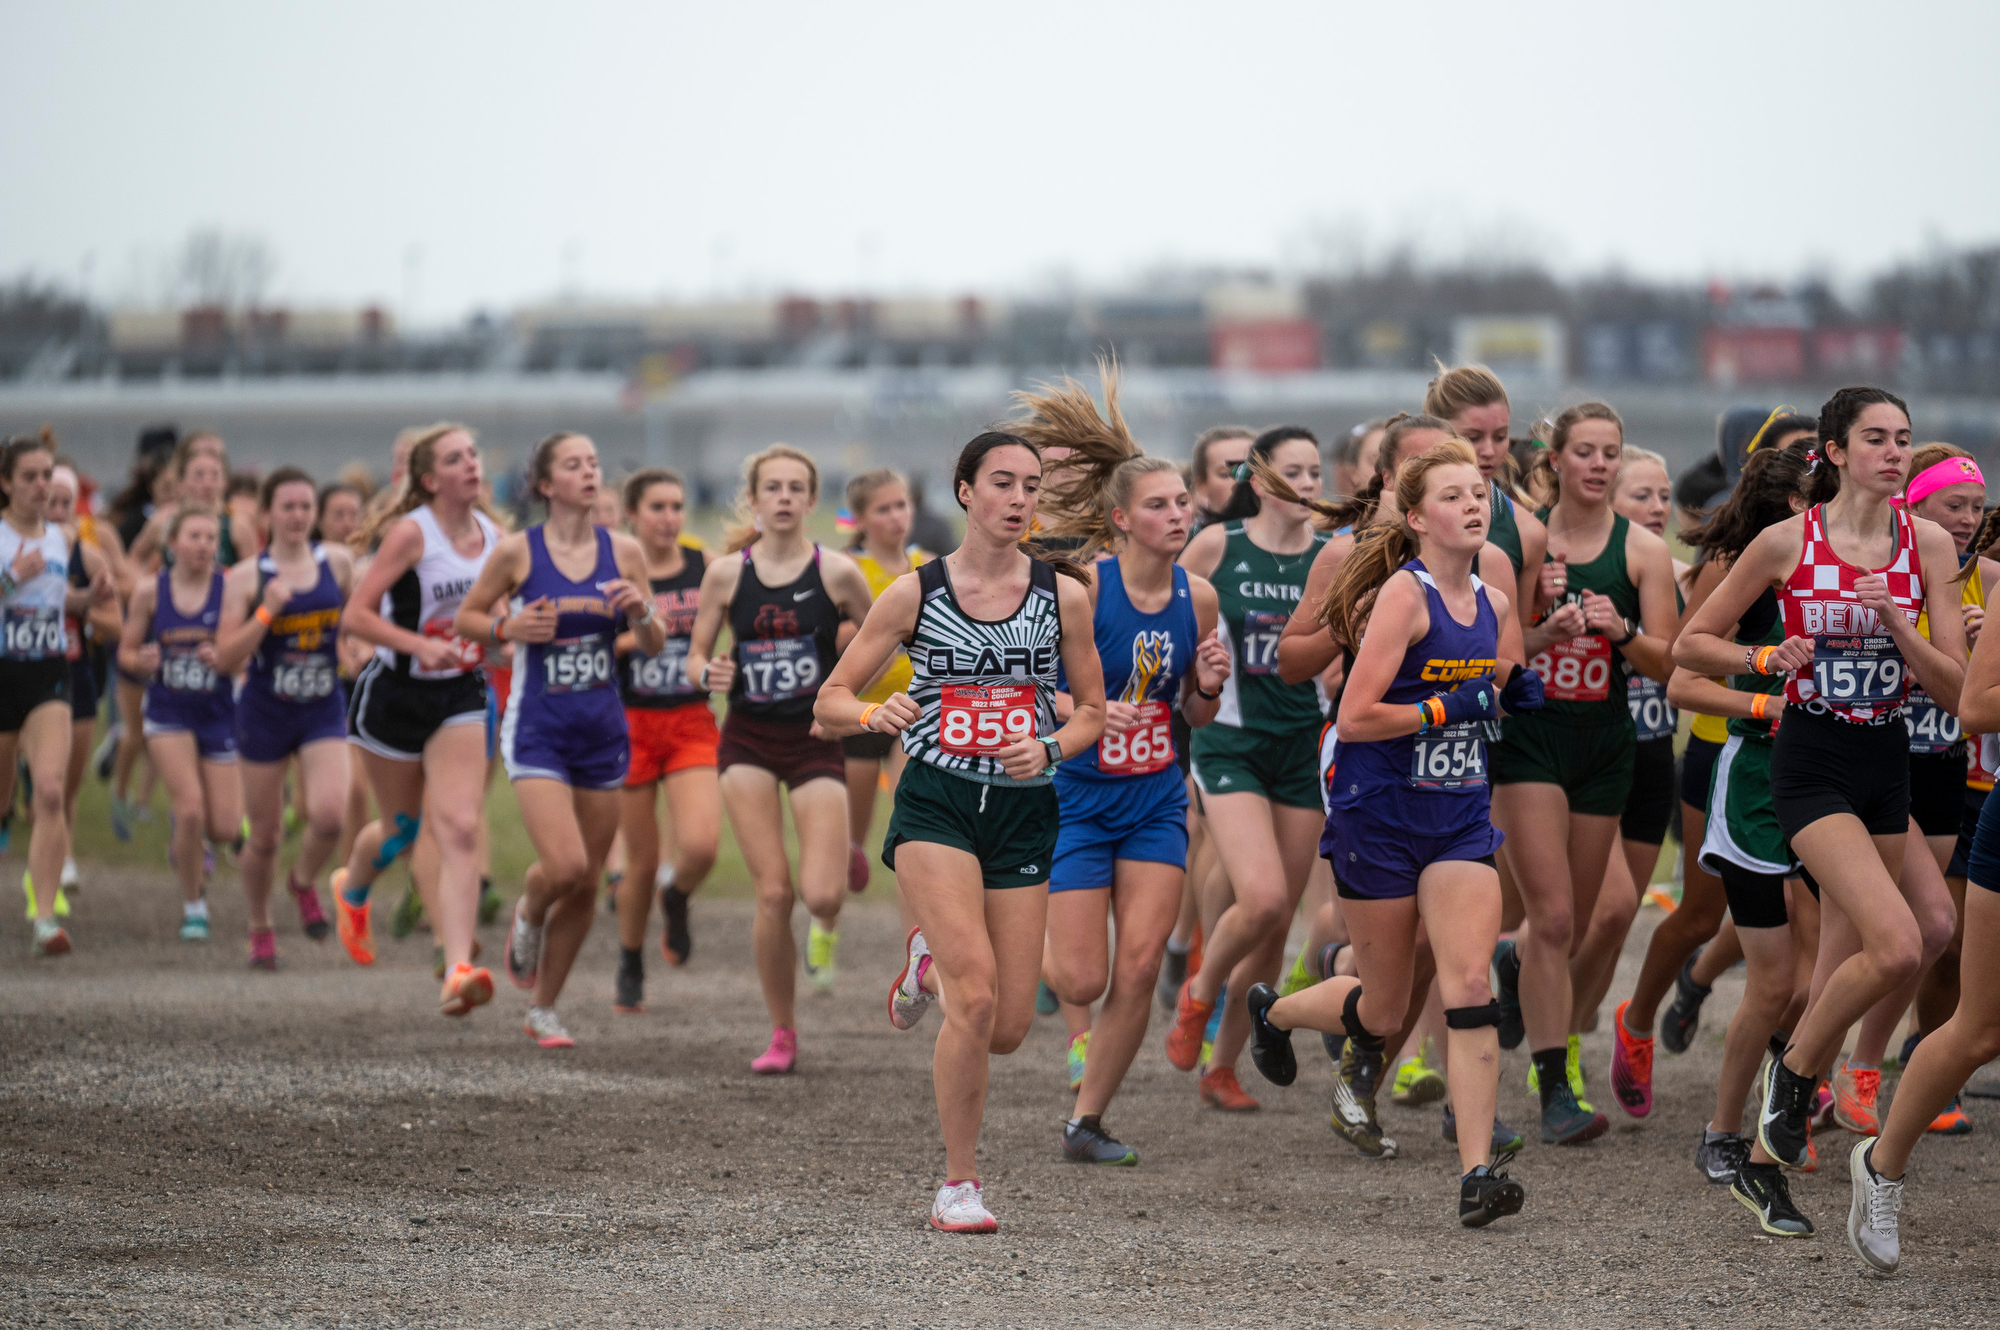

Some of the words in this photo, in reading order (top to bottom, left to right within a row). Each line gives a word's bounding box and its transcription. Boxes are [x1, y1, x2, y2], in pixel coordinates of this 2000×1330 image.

[6, 621, 60, 651] 1670
[1243, 632, 1279, 666] 17
[543, 649, 610, 685] 1590
[742, 656, 817, 695] 1739
[926, 646, 1053, 677] CLARE
[1528, 652, 1608, 689] 880
[1815, 659, 1901, 698] 1579
[971, 700, 988, 708] 2022
[989, 700, 1008, 708] FINAL
[991, 691, 1023, 700] COUNTRY
[943, 708, 1032, 746] 859
[1102, 725, 1170, 766] 865
[1415, 738, 1482, 777] 1654
